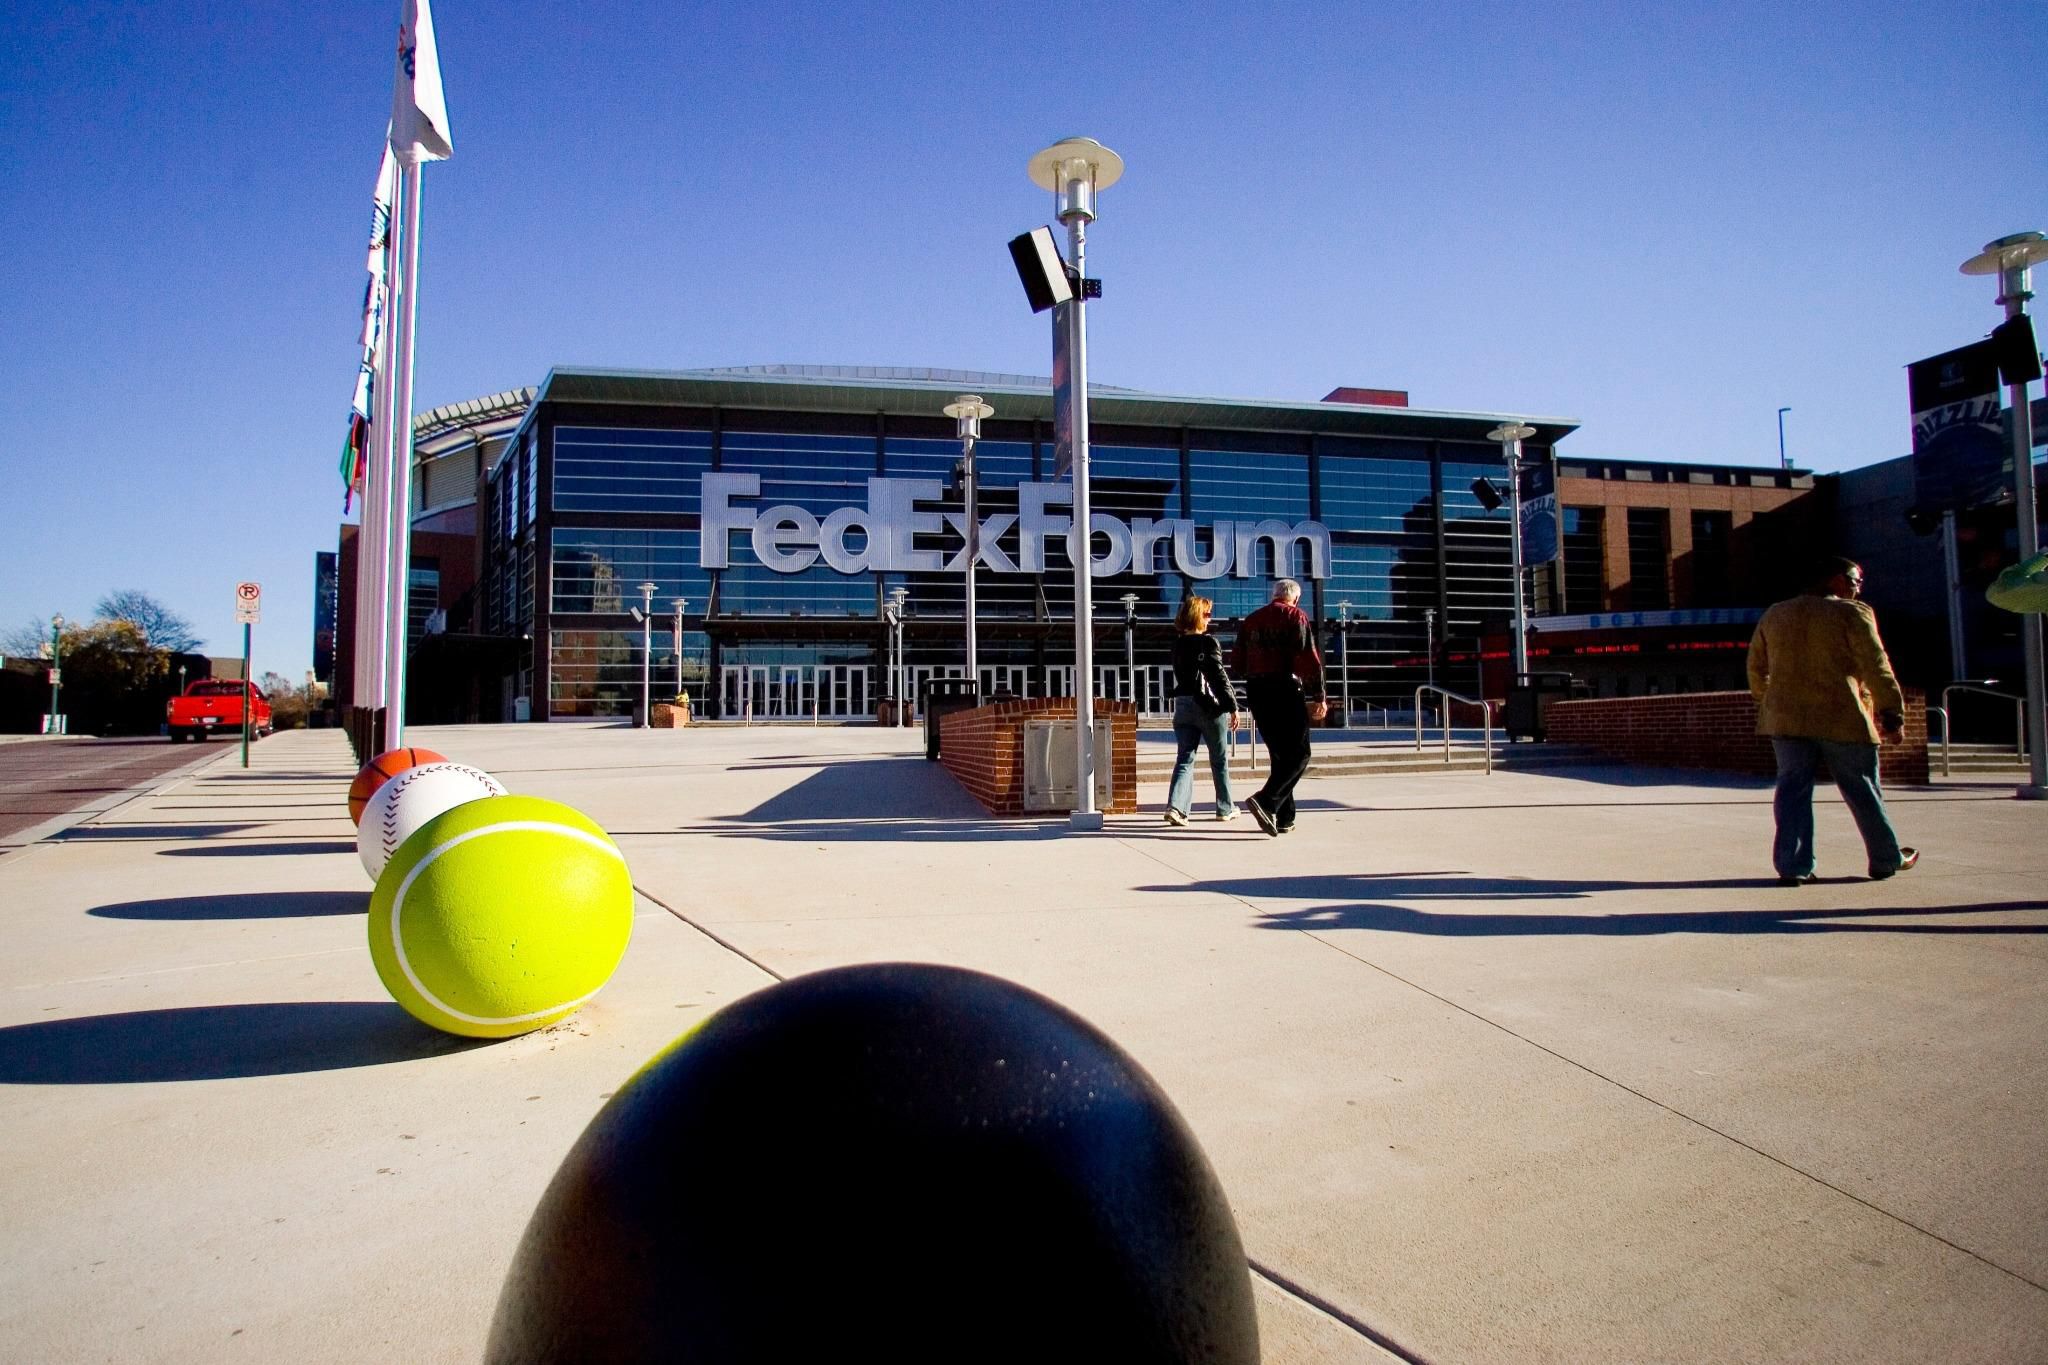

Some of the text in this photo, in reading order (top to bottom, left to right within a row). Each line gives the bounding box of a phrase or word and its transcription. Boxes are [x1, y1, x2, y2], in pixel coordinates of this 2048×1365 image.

[700, 471, 1332, 579] FedExForum
[1590, 608, 1758, 628] BOX OFFIC
